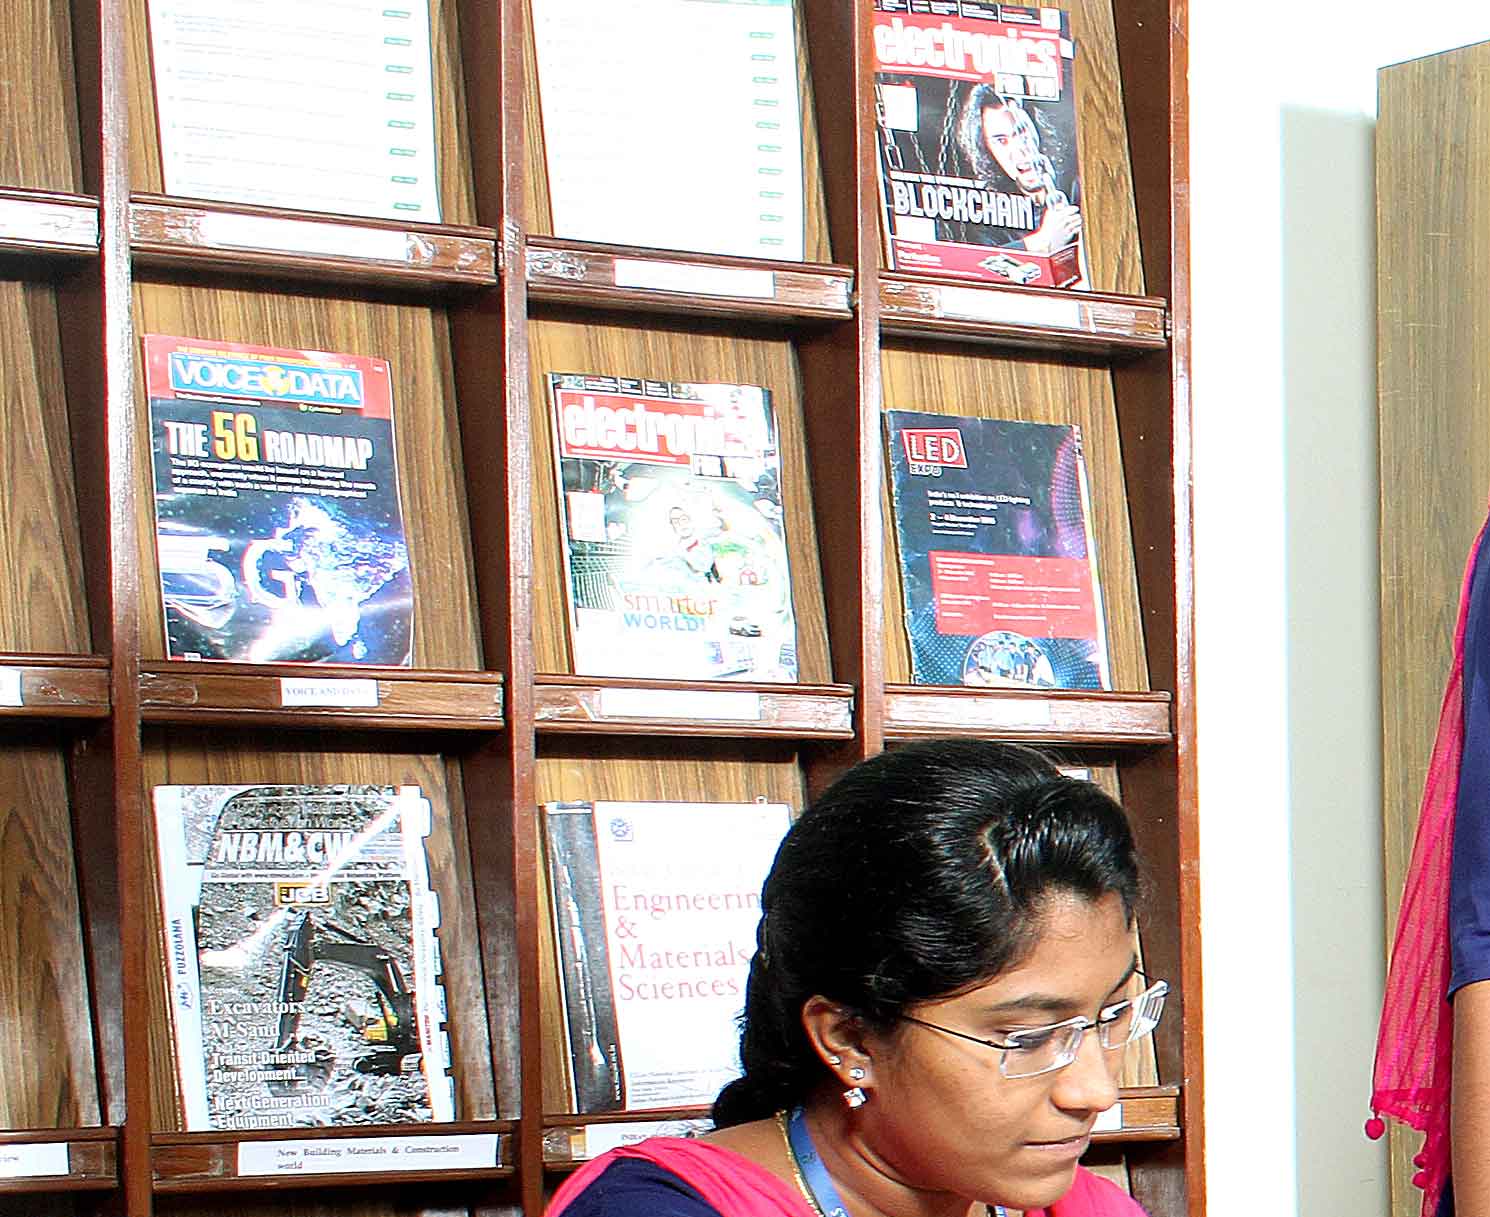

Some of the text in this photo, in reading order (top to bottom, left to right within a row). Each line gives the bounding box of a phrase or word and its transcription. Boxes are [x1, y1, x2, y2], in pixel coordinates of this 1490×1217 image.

[873, 17, 1057, 78] electronics
[892, 180, 1036, 230] BLOCKCHAIN
[164, 410, 374, 470] THE 5G ROADMAP
[909, 434, 961, 463] LED
[279, 887, 331, 903] JCB
[612, 885, 762, 920] Engineerin
[613, 916, 639, 940] &
[618, 941, 750, 969] Materials
[619, 974, 740, 1002] Sciences
[208, 999, 306, 1016] Excavators
[213, 1067, 299, 1083] Development
[249, 1092, 330, 1110] Generation
[217, 1112, 296, 1130] Equipment
[304, 1147, 342, 1158] Building
[347, 1146, 387, 1156] Materials
[404, 1143, 459, 1154] Construction
